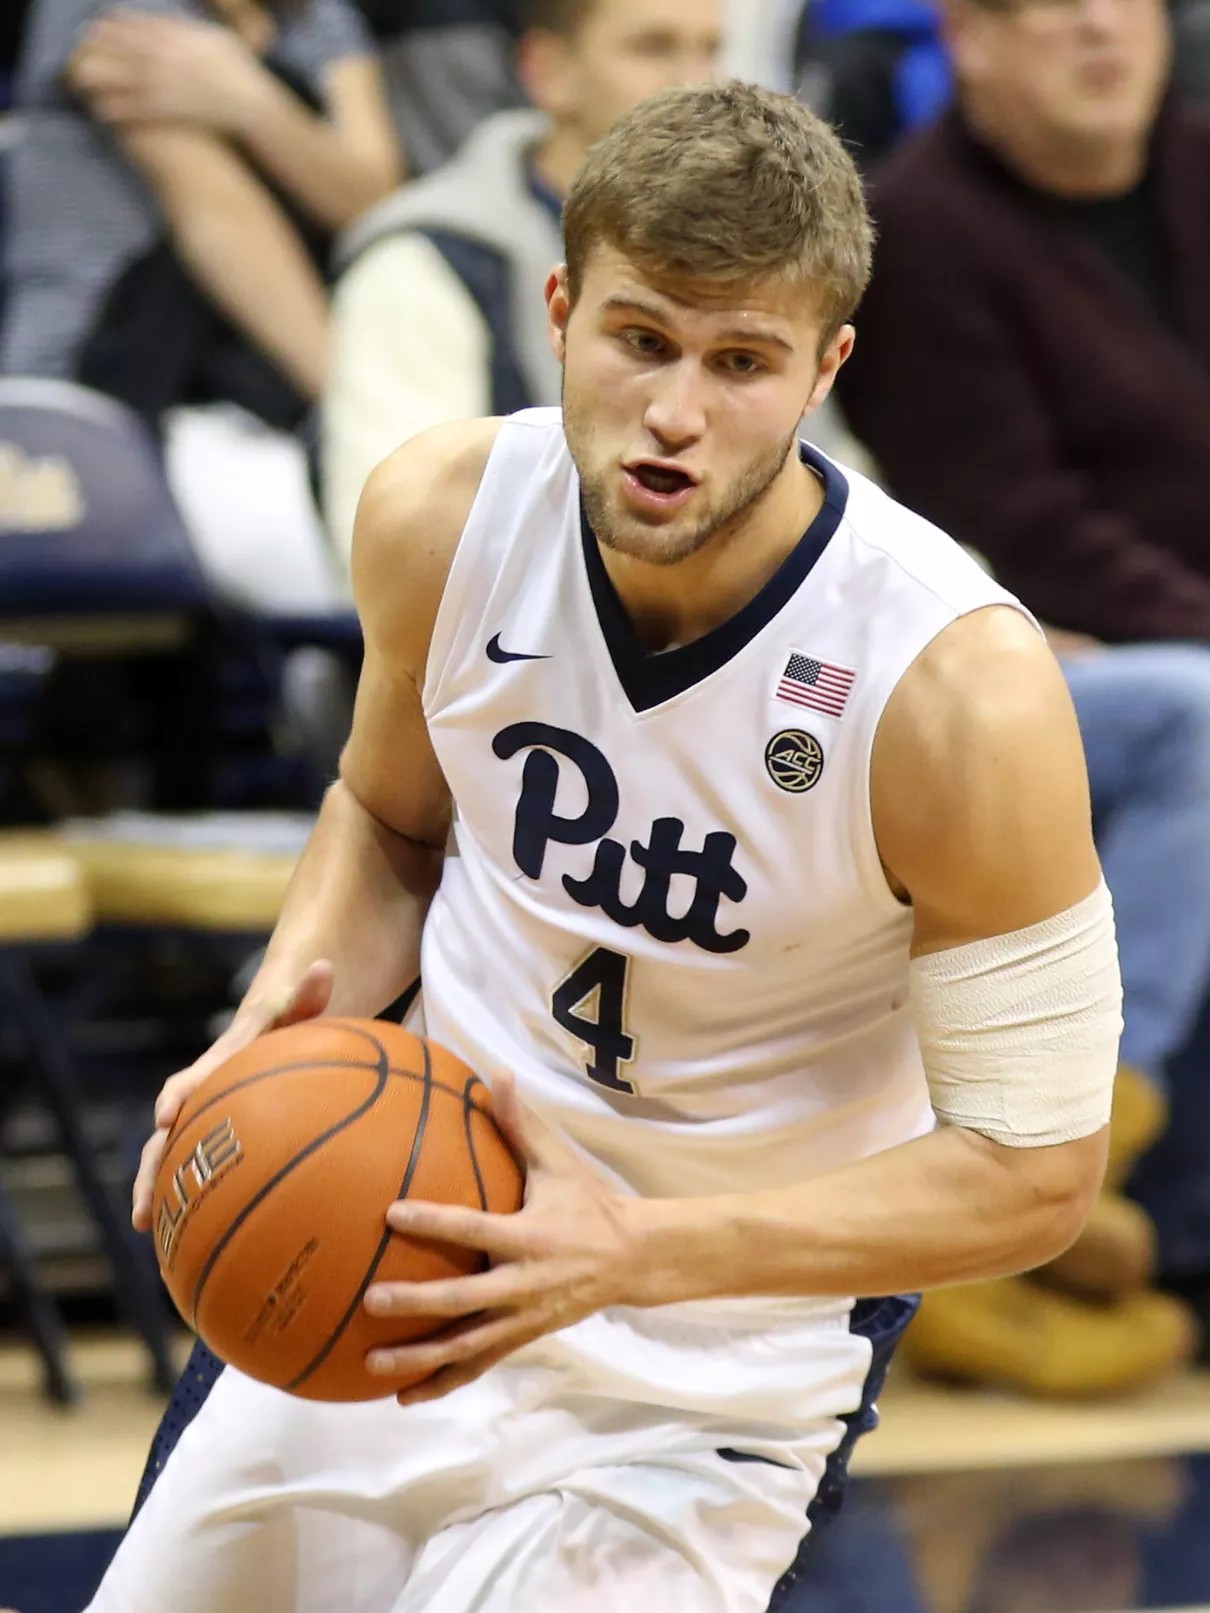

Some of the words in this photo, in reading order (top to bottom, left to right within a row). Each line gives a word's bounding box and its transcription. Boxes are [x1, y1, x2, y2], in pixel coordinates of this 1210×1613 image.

[773, 749, 822, 771] ACC
[491, 720, 750, 954] Pitt
[550, 944, 640, 1097] 4
